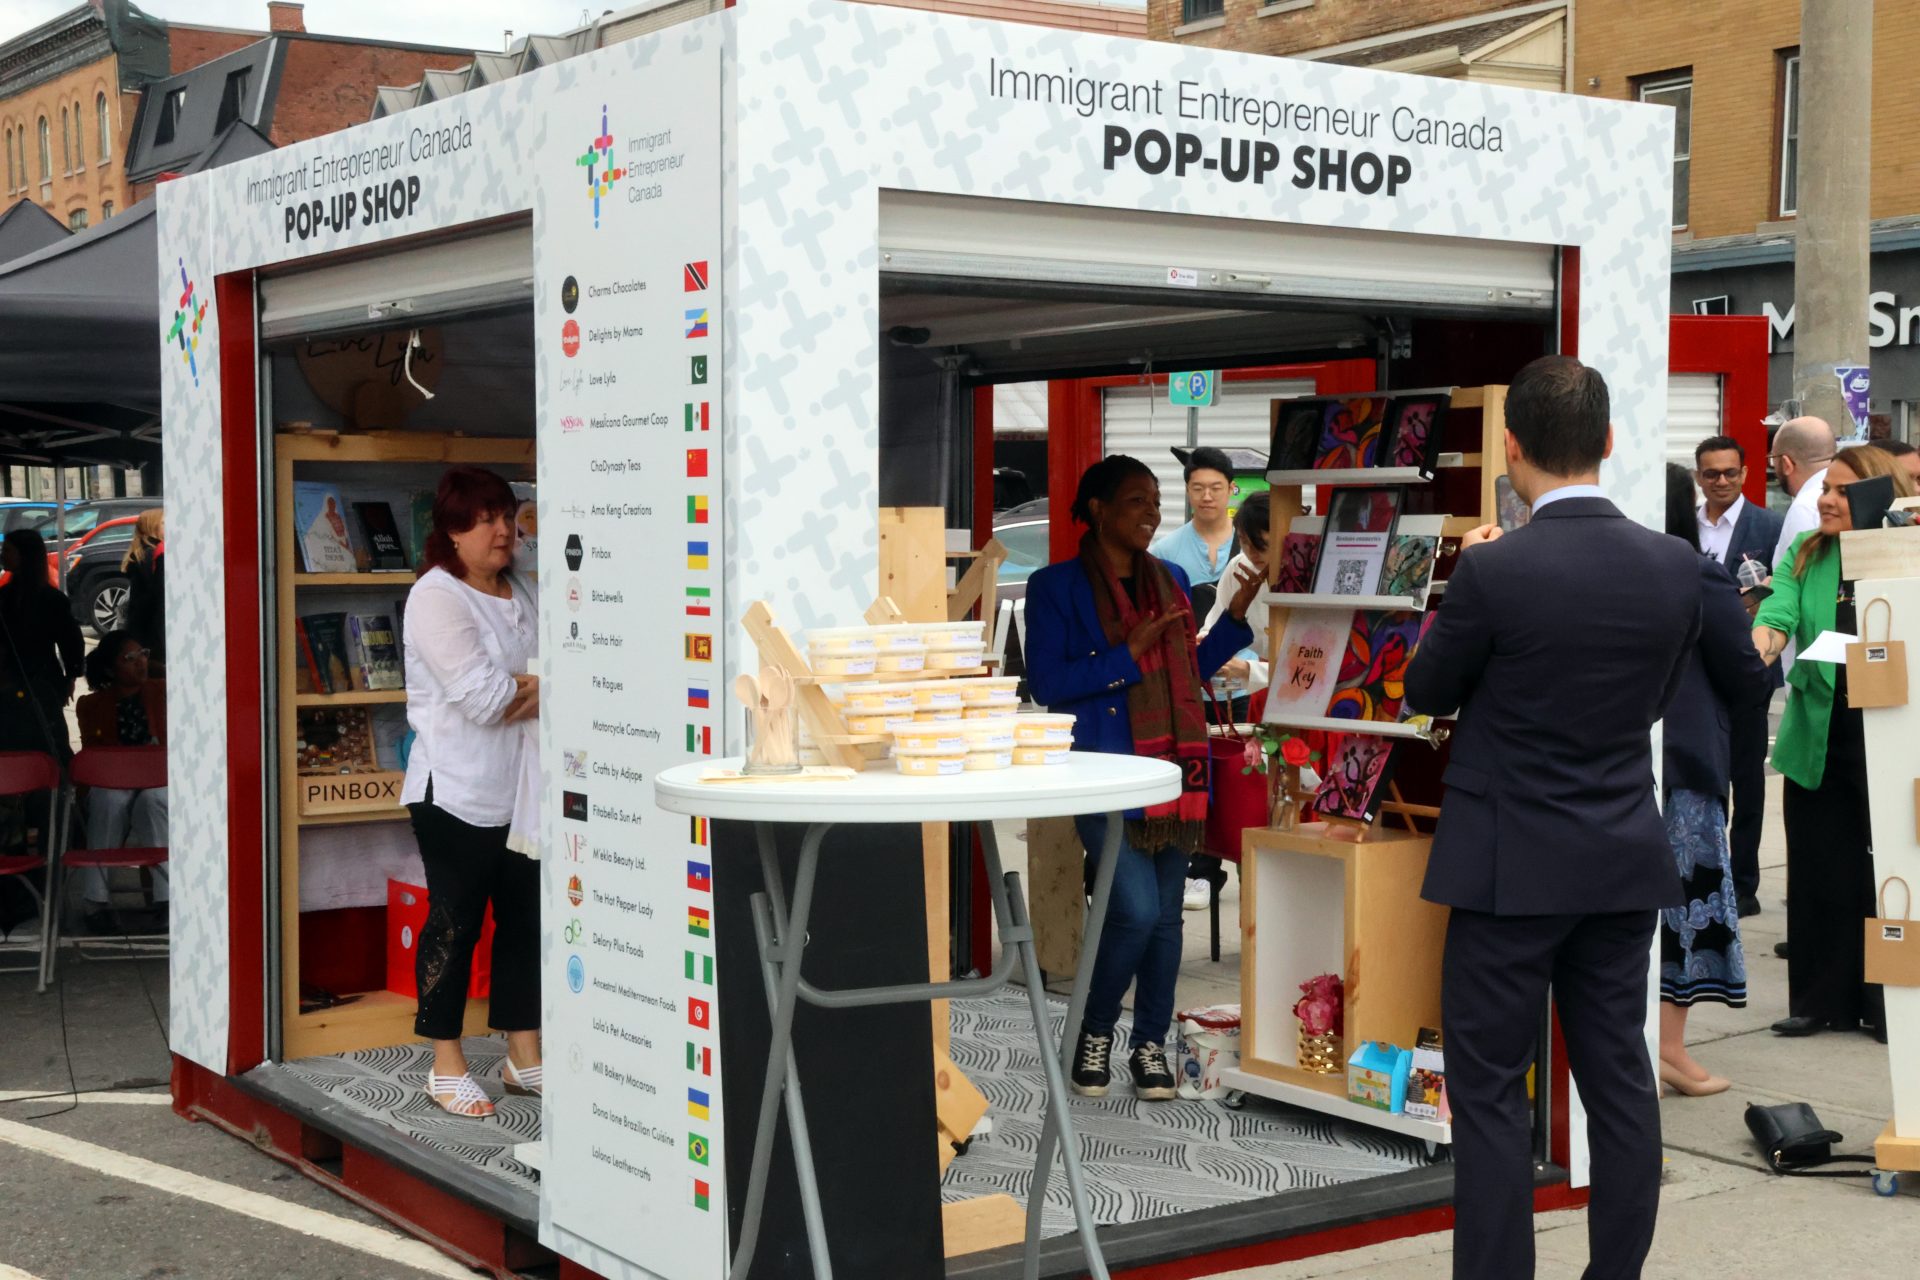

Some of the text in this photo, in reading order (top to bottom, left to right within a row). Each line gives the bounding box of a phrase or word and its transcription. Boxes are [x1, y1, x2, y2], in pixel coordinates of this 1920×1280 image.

[991, 57, 1504, 152] Immigrant Entrepreneur Canada
[628, 129, 671, 153] Immigrant
[247, 116, 472, 206] Immigrant Entrepreneur Canada
[628, 153, 685, 178] Entrepreneur
[1103, 125, 1412, 197] POP-UP SHOP
[628, 182, 662, 204] Canada
[285, 175, 420, 243] POP-UP SHOP
[588, 279, 647, 298] Charms Chocolates
[588, 327, 612, 344] Delights
[613, 326, 622, 342] by
[622, 326, 643, 338] Mama
[589, 373, 602, 385] Love
[603, 371, 617, 387] Lyla
[622, 415, 650, 428] Gourmet
[650, 412, 669, 429] Coop
[627, 459, 642, 471] Teas
[606, 504, 622, 519] Keng
[622, 503, 652, 516] Creations
[591, 547, 611, 559] Pinbox
[609, 635, 623, 647] Hair
[1297, 646, 1324, 660] Faith
[592, 676, 602, 688] Pie
[1291, 665, 1317, 690] Key
[592, 720, 661, 743] Motorcycle Community
[593, 761, 611, 776] Crafts
[611, 764, 620, 779] by
[308, 780, 395, 802] PINBOX
[619, 809, 631, 822] Sun
[631, 812, 642, 825] Art
[613, 850, 634, 870] Beauty
[593, 890, 654, 919] The Hot Pepper Lady
[613, 938, 625, 953] Plus
[625, 942, 644, 958] Foods
[592, 977, 677, 1013] Ancestral Mediterranean Foods
[610, 1023, 619, 1037] Pet
[592, 1060, 604, 1075] Mill
[604, 1064, 625, 1086] Bakery
[623, 1115, 651, 1137] Brazilian
[651, 1127, 675, 1147] Cuisine
[612, 1153, 652, 1182] Leathercrafts
